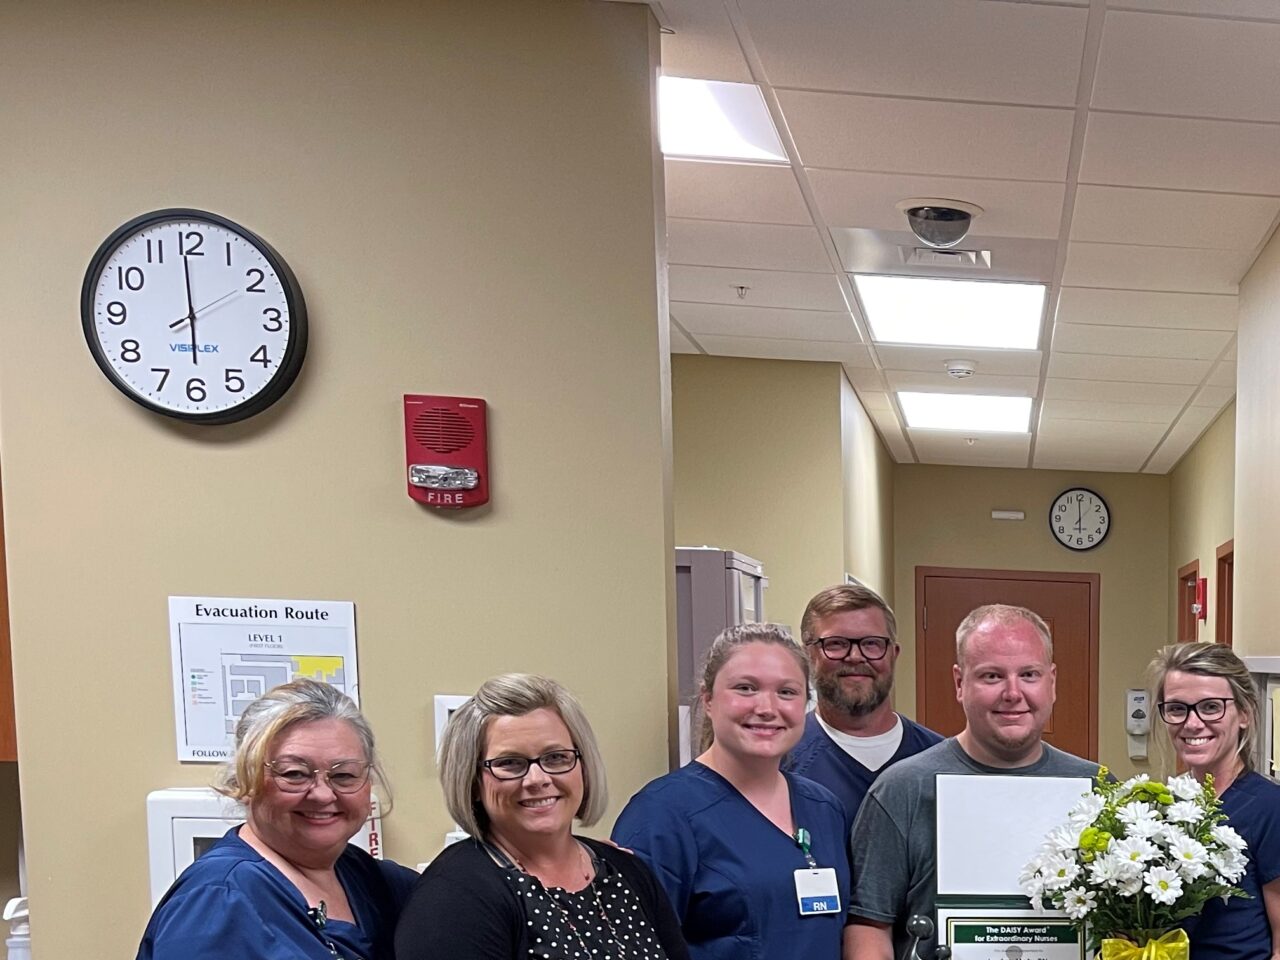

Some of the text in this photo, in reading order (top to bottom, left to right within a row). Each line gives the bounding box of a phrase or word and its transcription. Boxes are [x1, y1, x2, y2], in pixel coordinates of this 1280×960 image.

[178, 231, 205, 256] 12
[146, 239, 163, 263] 11
[226, 242, 232, 266] 1
[117, 266, 145, 291] 10
[245, 268, 266, 293] 2
[106, 301, 127, 325] 9
[262, 307, 283, 332] 3
[120, 339, 141, 363] 8
[249, 344, 272, 368] 4
[150, 368, 170, 392] 7
[225, 368, 245, 393] 5
[186, 378, 207, 402] 6
[428, 492, 464, 504] FIRE
[1067, 496, 1073, 504] 11
[1075, 494, 1084, 502] 12
[1058, 504, 1067, 513] 10
[1095, 504, 1102, 513] 2
[1054, 514, 1061, 522] 9
[1099, 516, 1106, 524] 3
[1058, 526, 1065, 534] 8
[1095, 527, 1102, 535] 4
[1067, 534, 1073, 542] 7
[1076, 537, 1083, 545] 6
[1087, 534, 1094, 542] 5
[195, 603, 329, 621] Evacuation Route
[248, 634, 275, 642] LEVEL
[192, 749, 227, 757] FOLLOW
[813, 901, 828, 911] RN
[986, 926, 1047, 934] The DAISY Award
[986, 935, 1034, 943] Extraordinary
